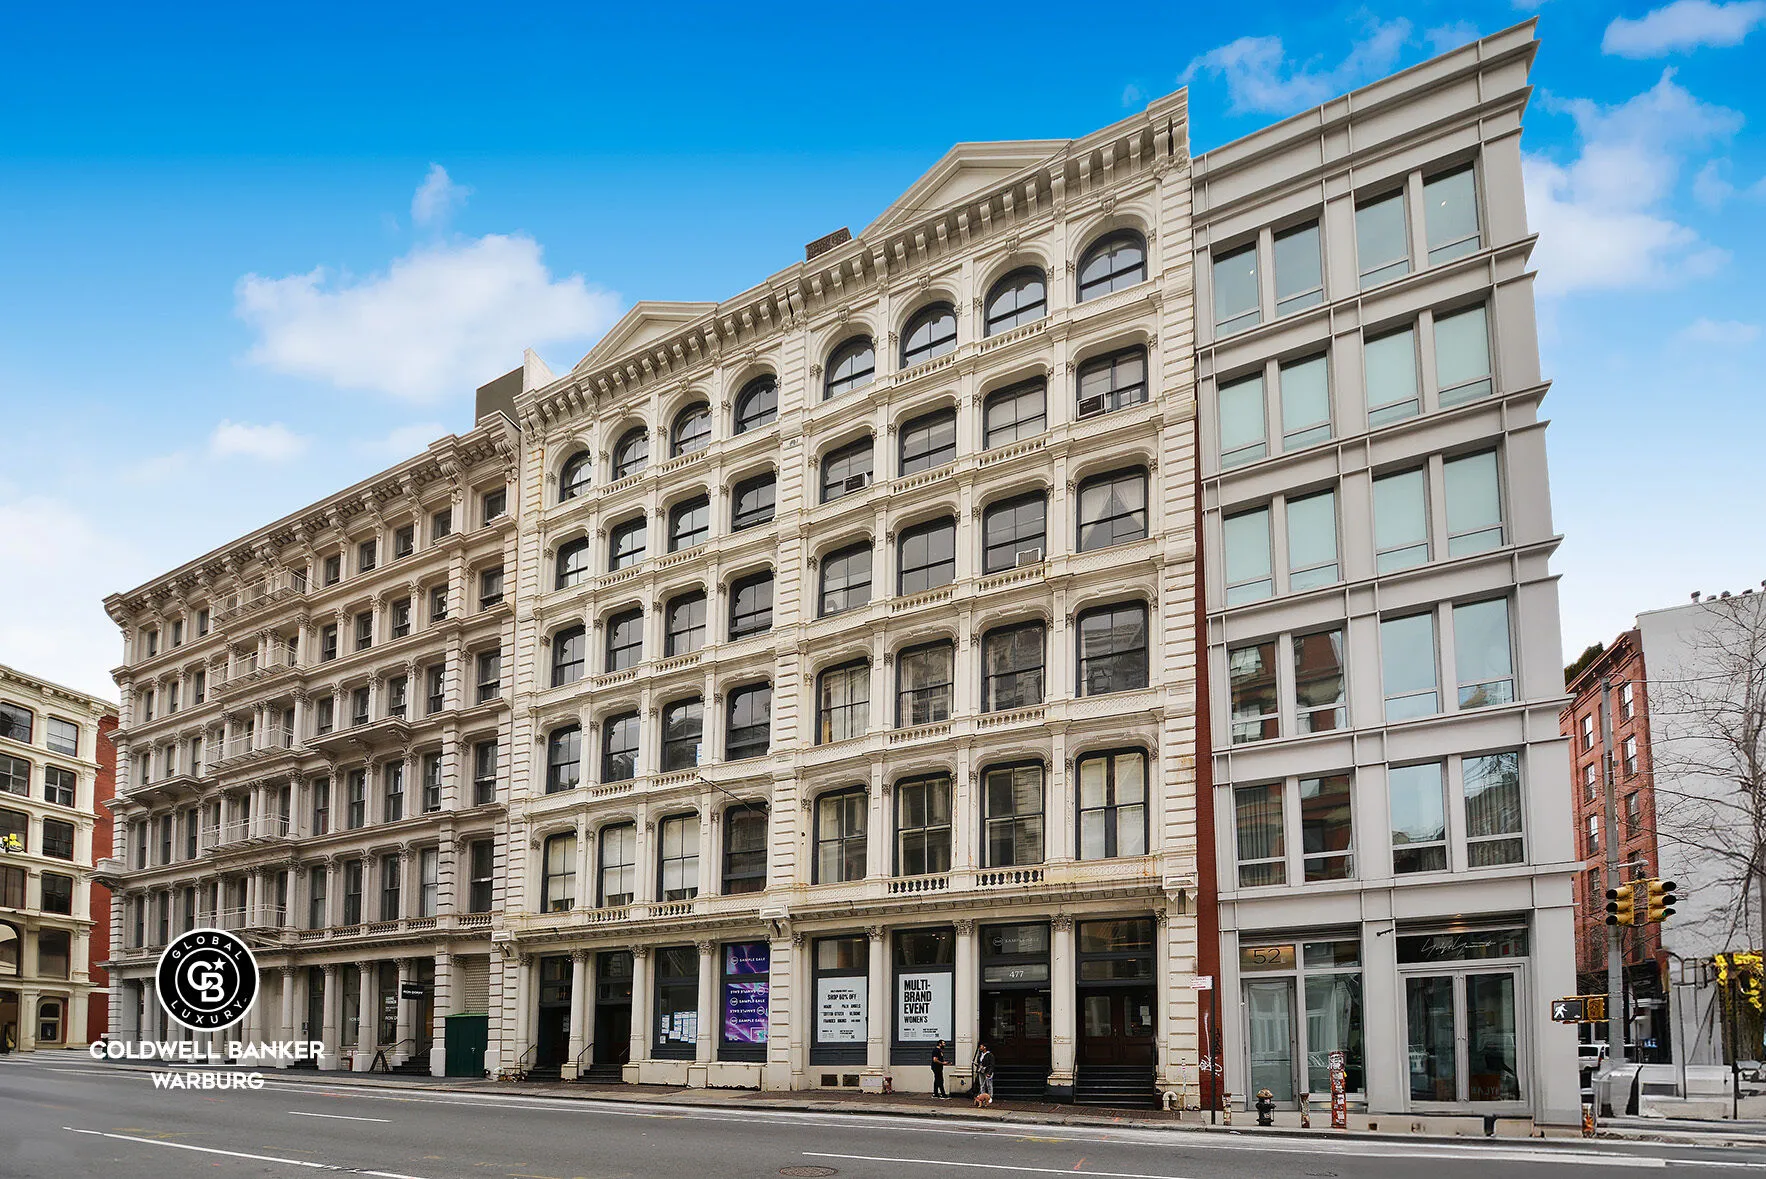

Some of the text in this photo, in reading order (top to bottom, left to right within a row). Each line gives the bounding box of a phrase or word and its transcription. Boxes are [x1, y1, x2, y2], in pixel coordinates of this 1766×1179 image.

[1253, 948, 1281, 965] 52
[1008, 970, 1025, 979] 477
[903, 979, 931, 991] MULTI-
[903, 990, 932, 1002] BRAND
[903, 1002, 930, 1014] EVENT
